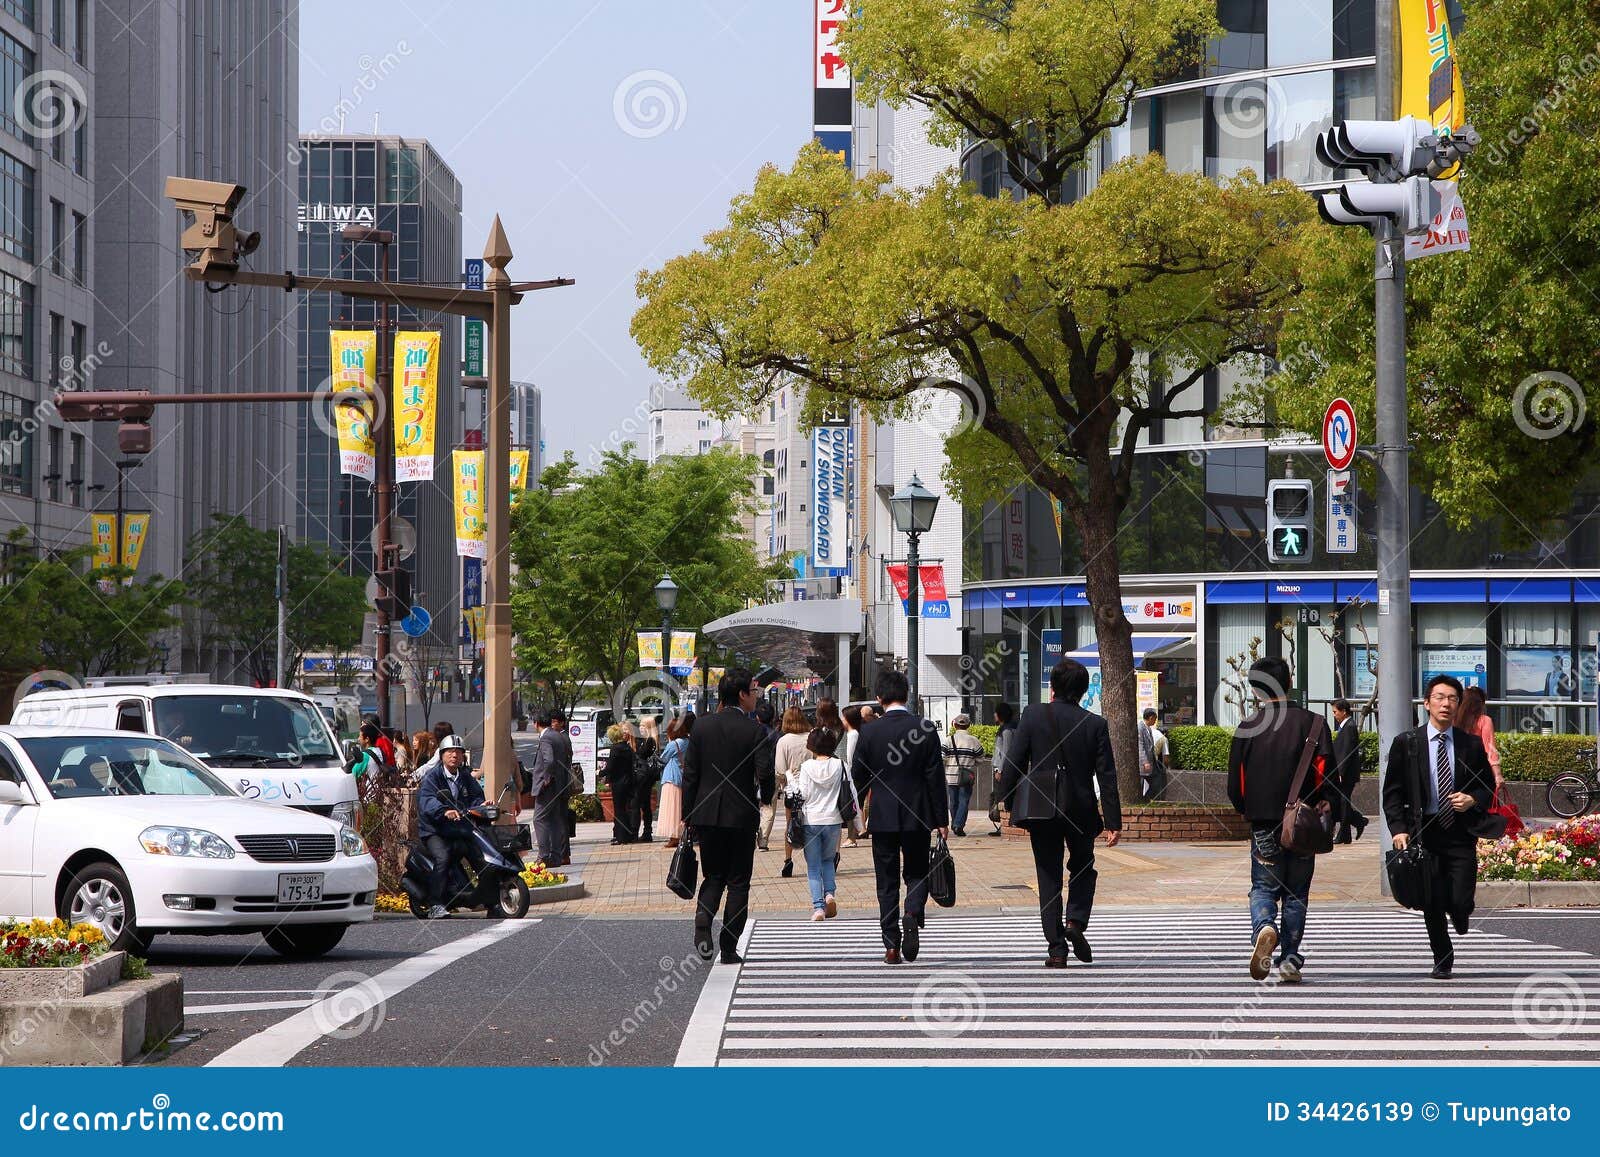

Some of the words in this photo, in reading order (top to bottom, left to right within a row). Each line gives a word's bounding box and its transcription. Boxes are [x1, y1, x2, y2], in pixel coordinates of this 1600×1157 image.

[402, 348, 429, 446] 神戸まつり
[818, 458, 830, 559] SNOWBOARD
[1276, 585, 1301, 593] MIZUHO
[728, 617, 764, 625] SANNOMIYA
[766, 617, 800, 628] CHUODORI
[288, 885, 321, 901] 75-43
